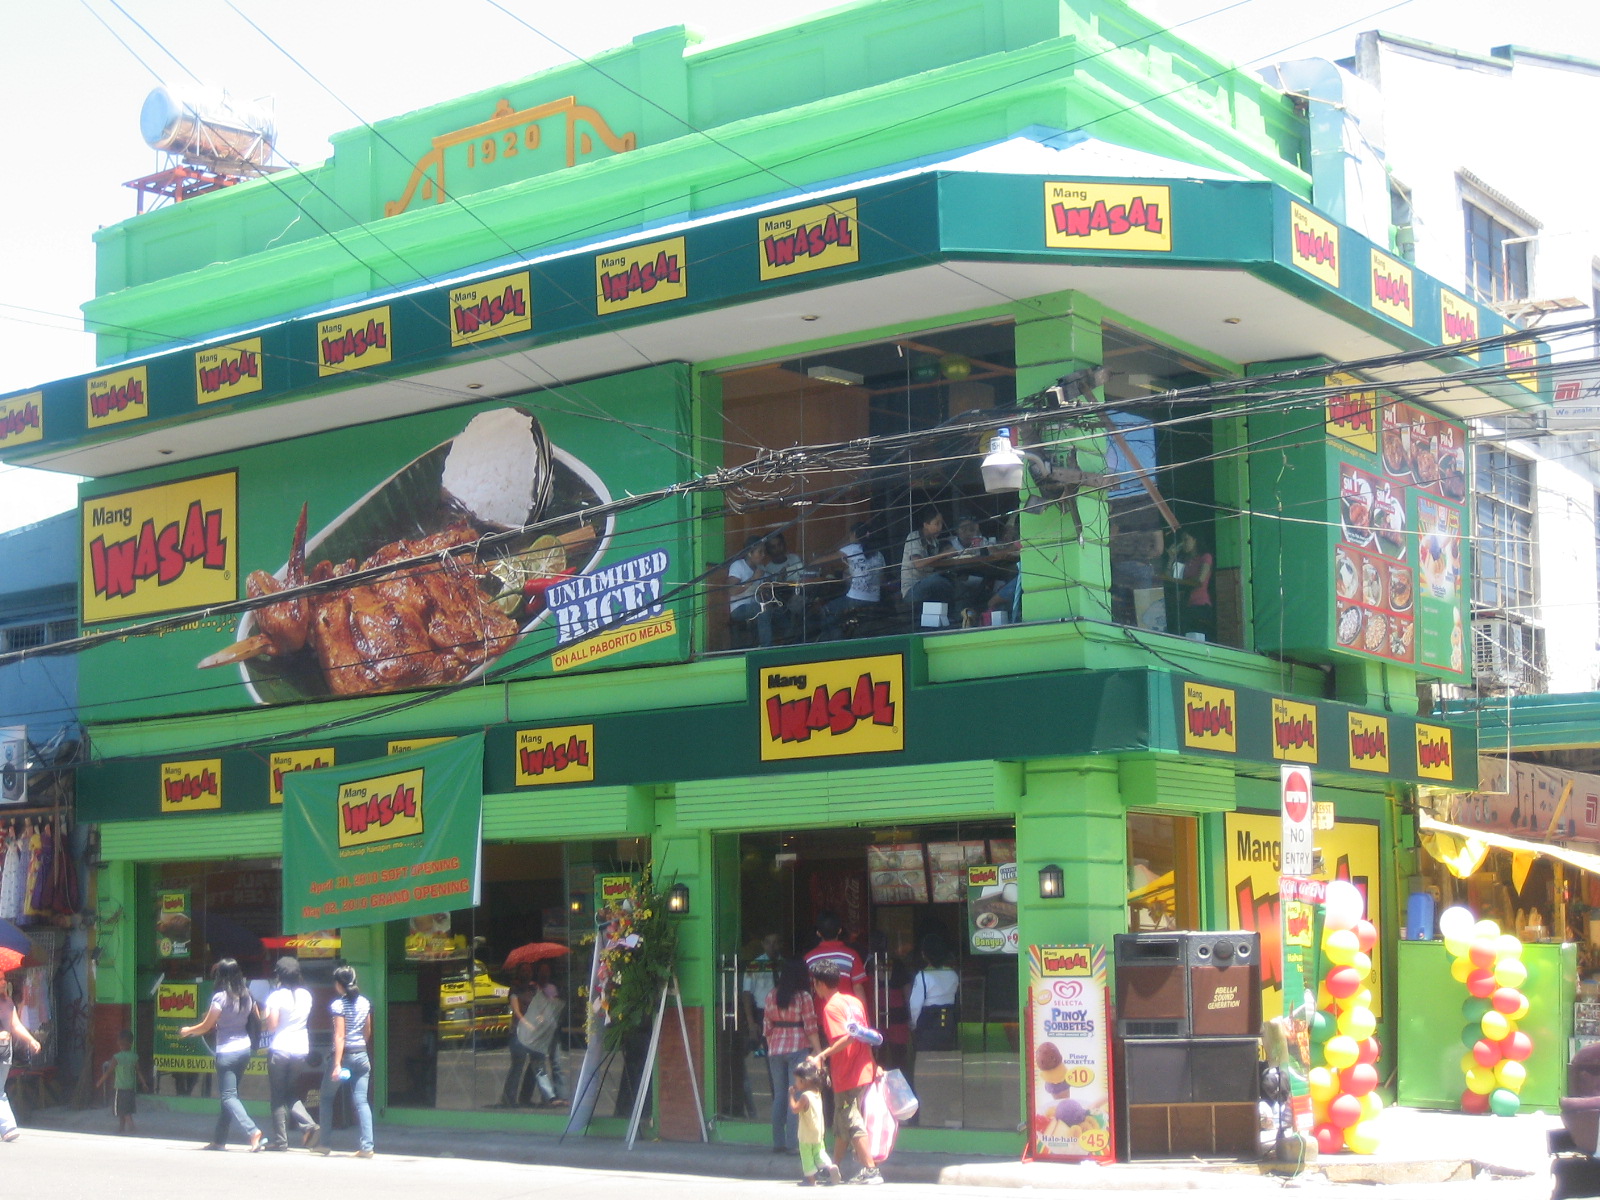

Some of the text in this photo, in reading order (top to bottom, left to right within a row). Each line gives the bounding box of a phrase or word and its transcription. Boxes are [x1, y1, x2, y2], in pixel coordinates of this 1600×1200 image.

[467, 124, 540, 168] 1920
[1053, 187, 1087, 201] Mang
[764, 218, 792, 231] Mang
[1051, 196, 1163, 237] INASAL
[1294, 208, 1309, 226] Mang
[764, 212, 852, 267] INASAL
[1294, 222, 1335, 270] INASAL
[601, 255, 626, 268] Mang
[600, 250, 680, 303] INASAL
[455, 290, 477, 301] Mang
[454, 285, 526, 335] INASAL
[322, 323, 342, 334] Mang
[321, 318, 386, 365] INASAL
[199, 352, 217, 364] Mang
[199, 349, 259, 393] INASAL
[90, 379, 107, 390] Mang
[90, 377, 144, 418] INASAL
[0, 401, 39, 440] NASAL
[92, 505, 132, 527] Mang
[89, 499, 227, 600] INASAL
[547, 551, 667, 608] UNLIMITED
[556, 578, 661, 643] RICE!
[555, 620, 673, 667] ON ALL PABORITO MEALS
[767, 672, 807, 690] Mang
[1187, 687, 1203, 702] Mang
[766, 672, 895, 744] INASAL
[1187, 698, 1233, 737] INASAL
[520, 733, 542, 744] Mang
[1274, 713, 1314, 750] INASAL
[1351, 725, 1386, 760] INASAL
[274, 756, 292, 766] Mang
[519, 734, 589, 775] INASAL
[1418, 736, 1450, 769] INASAL
[165, 766, 182, 777] Mang
[164, 768, 218, 804] INASAL
[344, 787, 367, 798] Mang
[342, 784, 416, 834] INASAL
[1290, 828, 1305, 843] NO
[1237, 830, 1282, 871] Mang
[1285, 852, 1310, 865] ENTRY
[310, 880, 334, 894] April
[381, 867, 409, 882] SOFT
[411, 857, 461, 877] OPENING
[303, 905, 321, 919] May
[342, 898, 367, 912] 2010
[370, 889, 410, 908] GRAND
[414, 878, 471, 900] OPENING
[975, 936, 1004, 948] Bangus
[1044, 953, 1088, 971] INASAL
[1213, 993, 1235, 1002] SOUND
[1215, 985, 1238, 995] ABELLA
[1051, 1008, 1087, 1021] PINOY
[1207, 1000, 1240, 1010] GENERATION
[1044, 1020, 1095, 1032] SORBETES
[187, 1059, 208, 1069] BLVD.
[1042, 1135, 1077, 1143] Halo-halo
